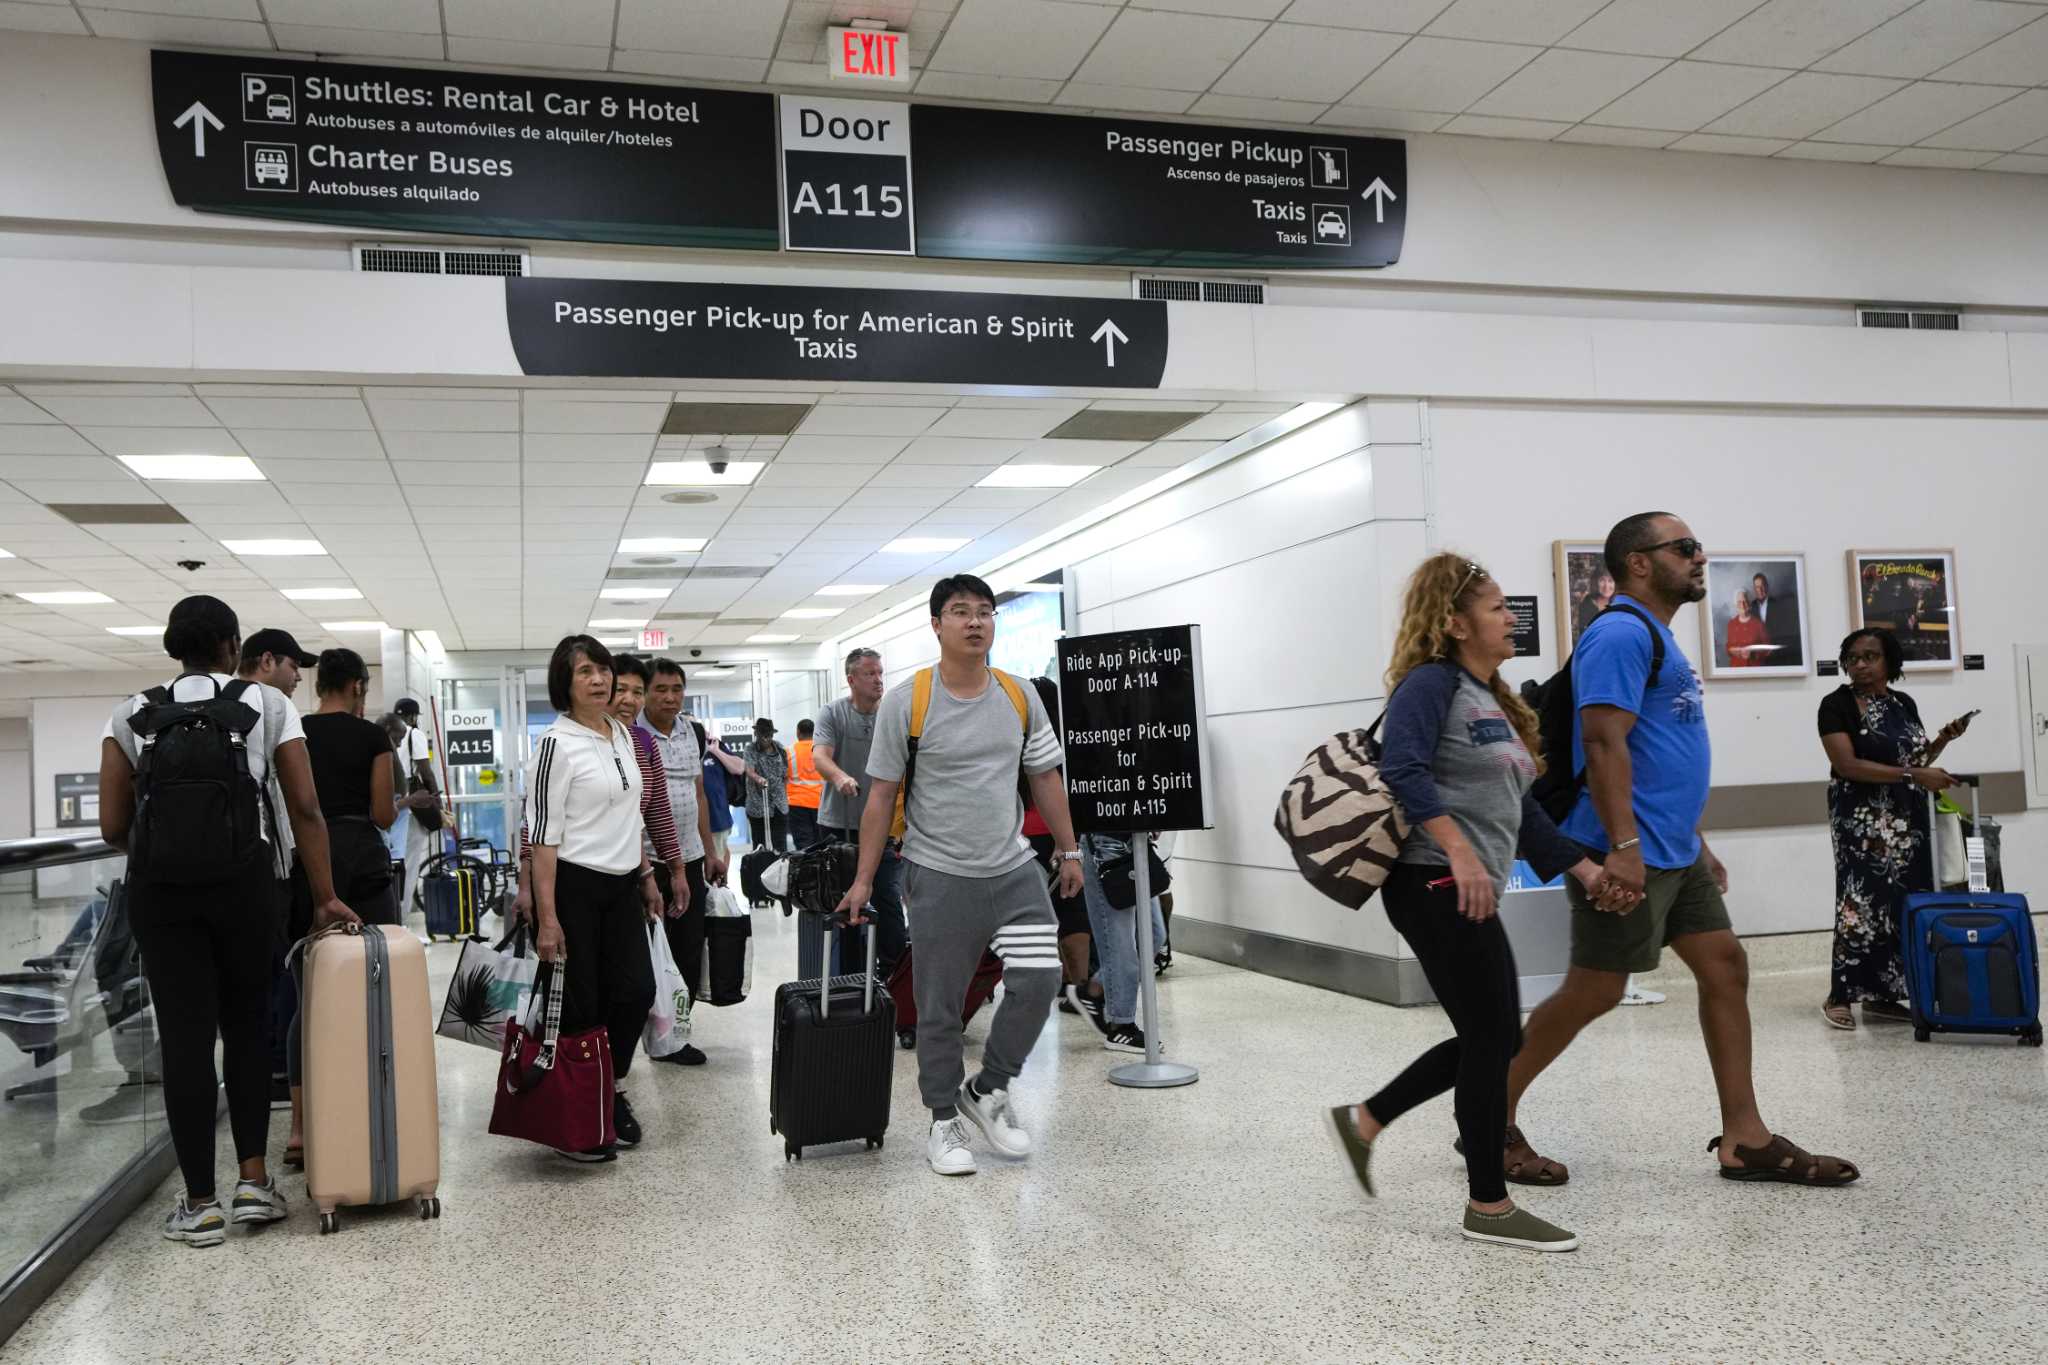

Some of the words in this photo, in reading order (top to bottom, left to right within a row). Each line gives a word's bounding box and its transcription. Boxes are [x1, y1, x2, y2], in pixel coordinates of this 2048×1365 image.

[843, 31, 898, 77] EXIT
[305, 76, 433, 107] Shuttles:
[443, 85, 535, 113] Rental
[543, 92, 591, 116] Car
[600, 96, 619, 118] &
[628, 97, 700, 124] Hotel
[305, 112, 396, 131] Autobuses
[400, 120, 411, 132] a
[415, 120, 516, 138] automóviles
[520, 125, 541, 140] de
[545, 127, 673, 148] alquiler/hoteles
[799, 108, 891, 142] Door
[308, 144, 419, 172] Charter
[429, 151, 513, 177] Buses
[1106, 131, 1223, 162] Passenger
[1231, 140, 1304, 169] Pickup
[1166, 166, 1221, 182] Ascenso
[1225, 170, 1241, 183] de
[1244, 173, 1305, 189] pasajeros
[308, 180, 398, 198] Autobuses
[402, 184, 480, 203] alquilado
[792, 181, 903, 218] A115
[1251, 199, 1306, 221] Taxis
[1275, 231, 1308, 245] Taxis
[554, 301, 697, 332] Passenger
[706, 306, 804, 333] Pick-up
[813, 309, 850, 331] for
[858, 310, 978, 336] American
[986, 315, 1004, 336] &
[1010, 316, 1075, 340] Spirit
[794, 337, 858, 360] Taxis
[643, 631, 666, 647] EXIT
[1066, 654, 1093, 672] Ride
[1098, 652, 1123, 671] App
[1129, 646, 1182, 666] Pick-up
[1088, 677, 1118, 693] Door
[1124, 671, 1159, 690] A-114
[452, 714, 487, 726] Door
[724, 723, 748, 732] Door
[1068, 726, 1132, 746] Passenger
[1138, 721, 1191, 742] Pick-up
[449, 739, 492, 754] A115
[1117, 749, 1137, 767] for
[1070, 776, 1130, 794] American
[1137, 775, 1146, 791] &
[1152, 771, 1193, 793] Spirit
[1096, 801, 1126, 817] Door
[1133, 798, 1167, 816] A-115
